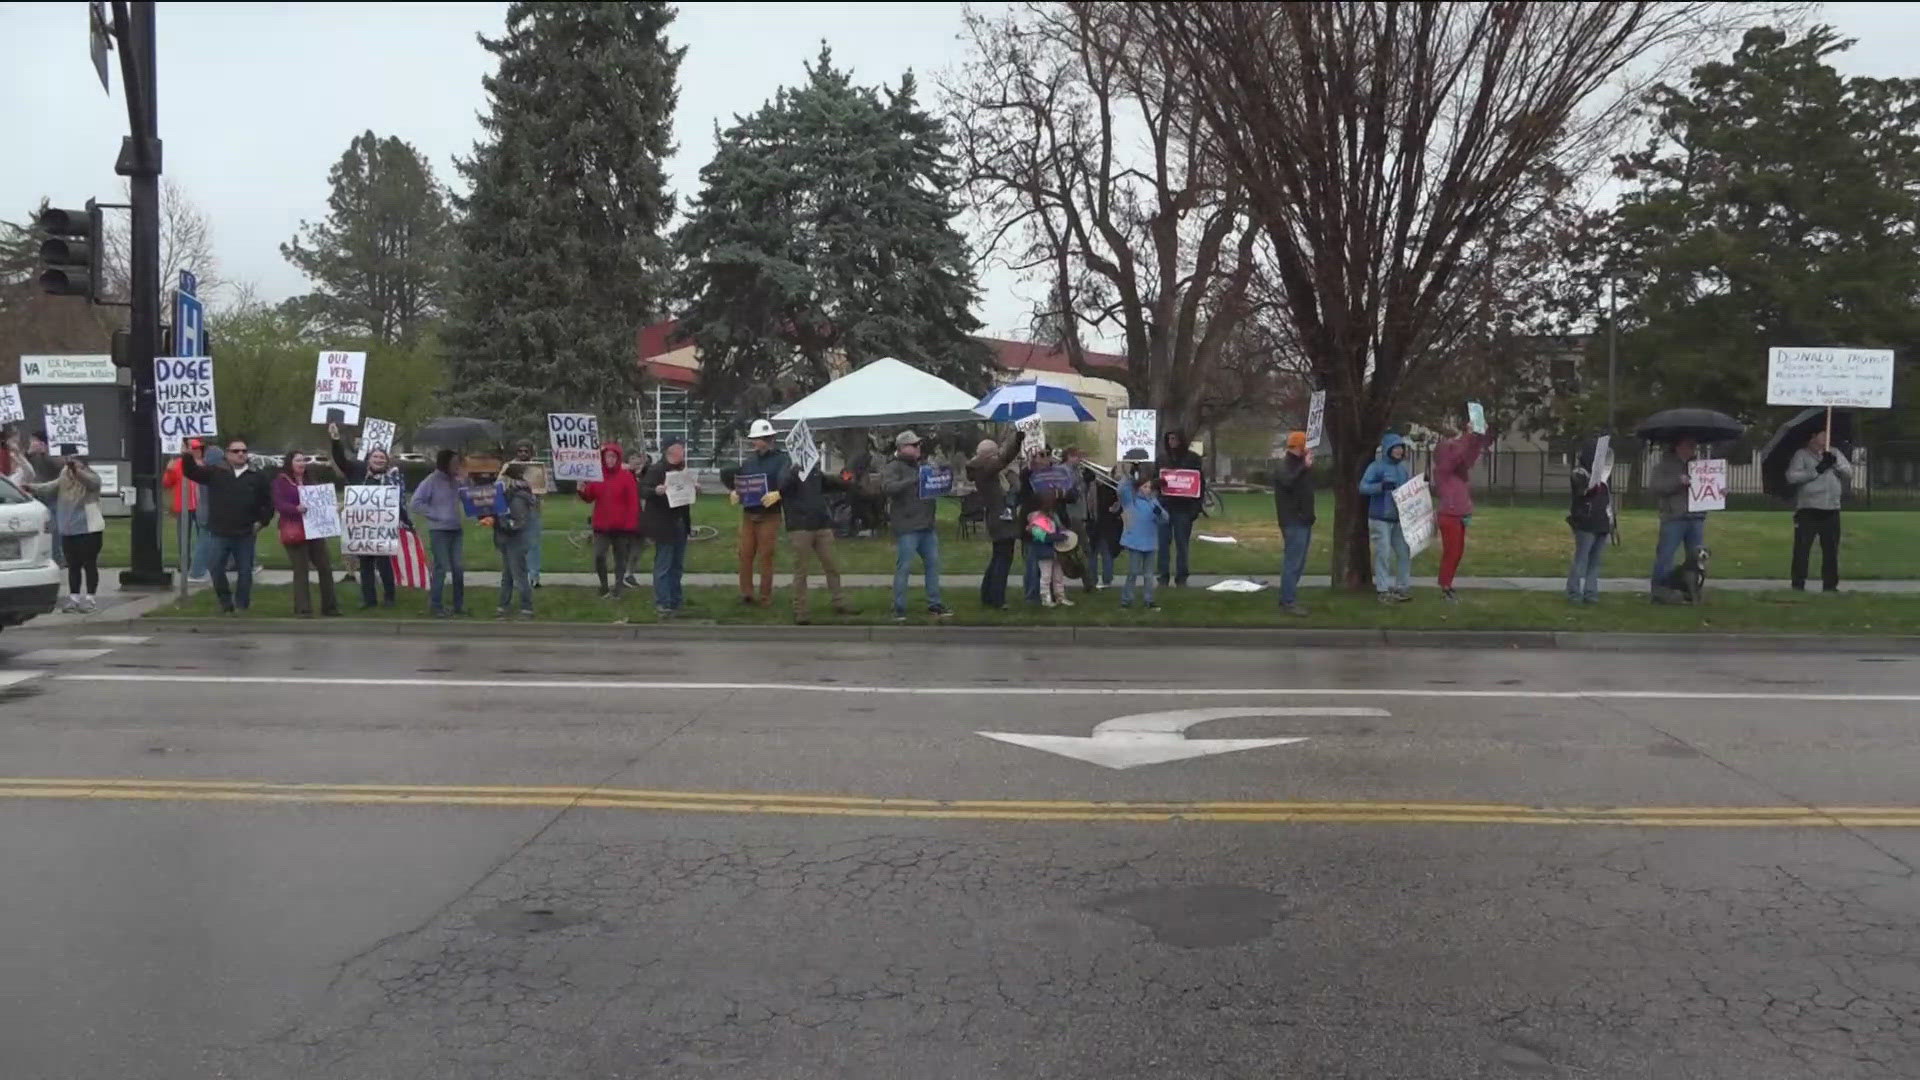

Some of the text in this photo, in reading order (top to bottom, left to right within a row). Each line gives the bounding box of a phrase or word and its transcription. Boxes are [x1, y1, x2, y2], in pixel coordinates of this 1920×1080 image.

[183, 303, 198, 357] H
[328, 353, 348, 364] OUR
[1776, 350, 1833, 363] DONALD
[25, 363, 40, 376] VA
[63, 359, 107, 369] Department
[156, 360, 211, 381] DOGE
[57, 370, 87, 378] Veterans
[90, 370, 115, 378] Affairs
[330, 366, 352, 380] VETS
[158, 382, 210, 400] HURTS
[316, 379, 358, 393] ARE NOT
[68, 405, 83, 416] US
[157, 399, 212, 415] VETERAN
[1121, 409, 1140, 420] LET
[161, 415, 214, 436] CARE
[550, 415, 596, 432] DOGE
[558, 462, 597, 477] CARE
[345, 487, 398, 509] DOGE
[346, 508, 396, 524] HURTS
[347, 525, 399, 540] VETERAN
[347, 541, 392, 552] CARE!
